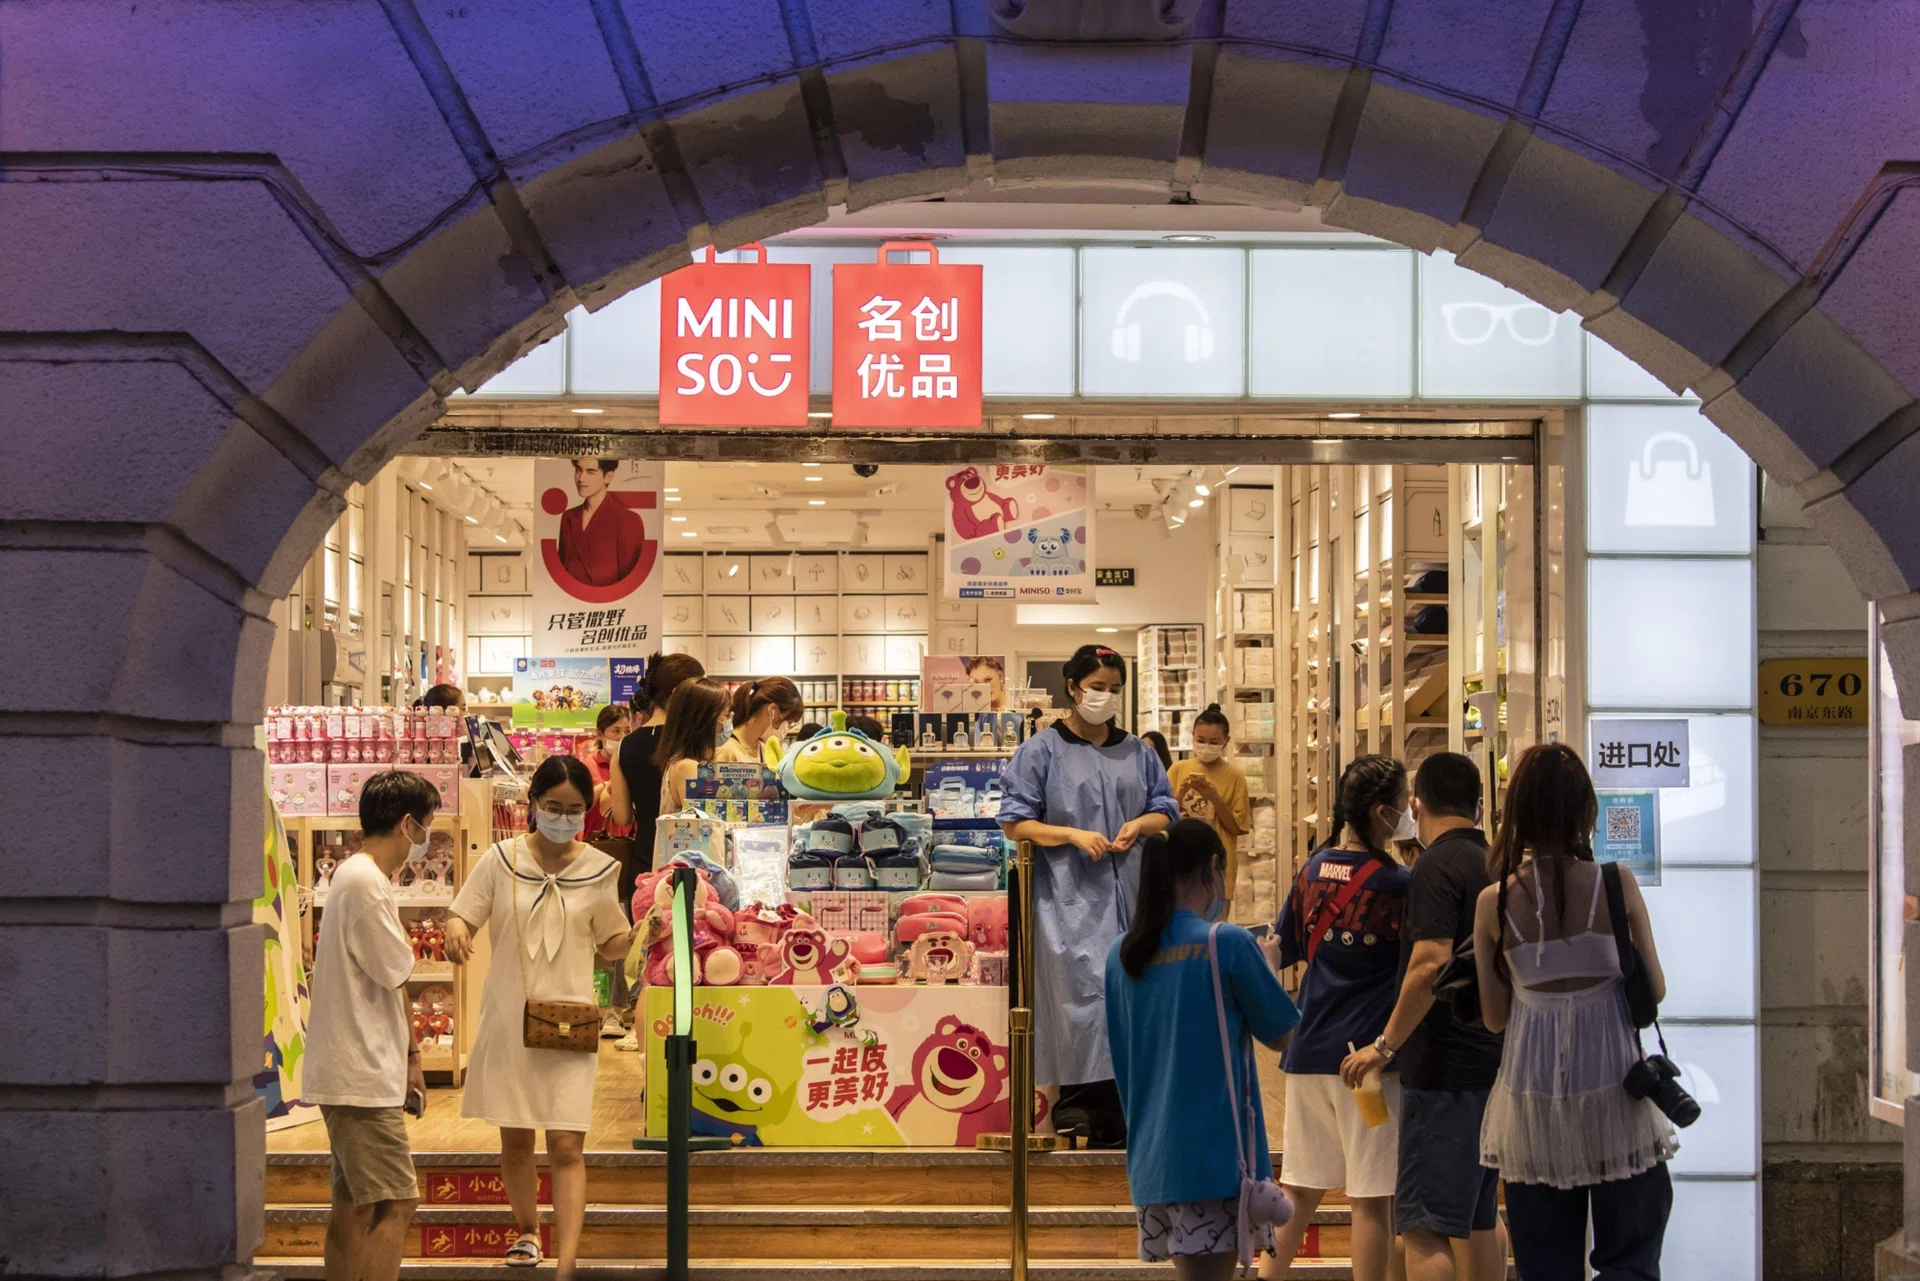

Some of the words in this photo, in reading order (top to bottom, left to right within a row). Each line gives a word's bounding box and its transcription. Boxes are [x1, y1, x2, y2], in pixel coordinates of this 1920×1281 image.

[677, 297, 793, 338] MINI
[858, 295, 958, 342] 名创
[856, 352, 958, 399] 优品
[1019, 587, 1050, 595] MINISO
[547, 608, 626, 631] 只管撒野
[581, 624, 648, 645] 名创优品
[1780, 673, 1861, 696] 670
[1788, 705, 1852, 719] 南京东路
[1599, 741, 1681, 768] 进口处
[719, 766, 757, 774] MONSTERS
[1319, 862, 1352, 881] MARVEL
[806, 1072, 889, 1112] 更美好
[464, 1228, 520, 1245] 小心台
